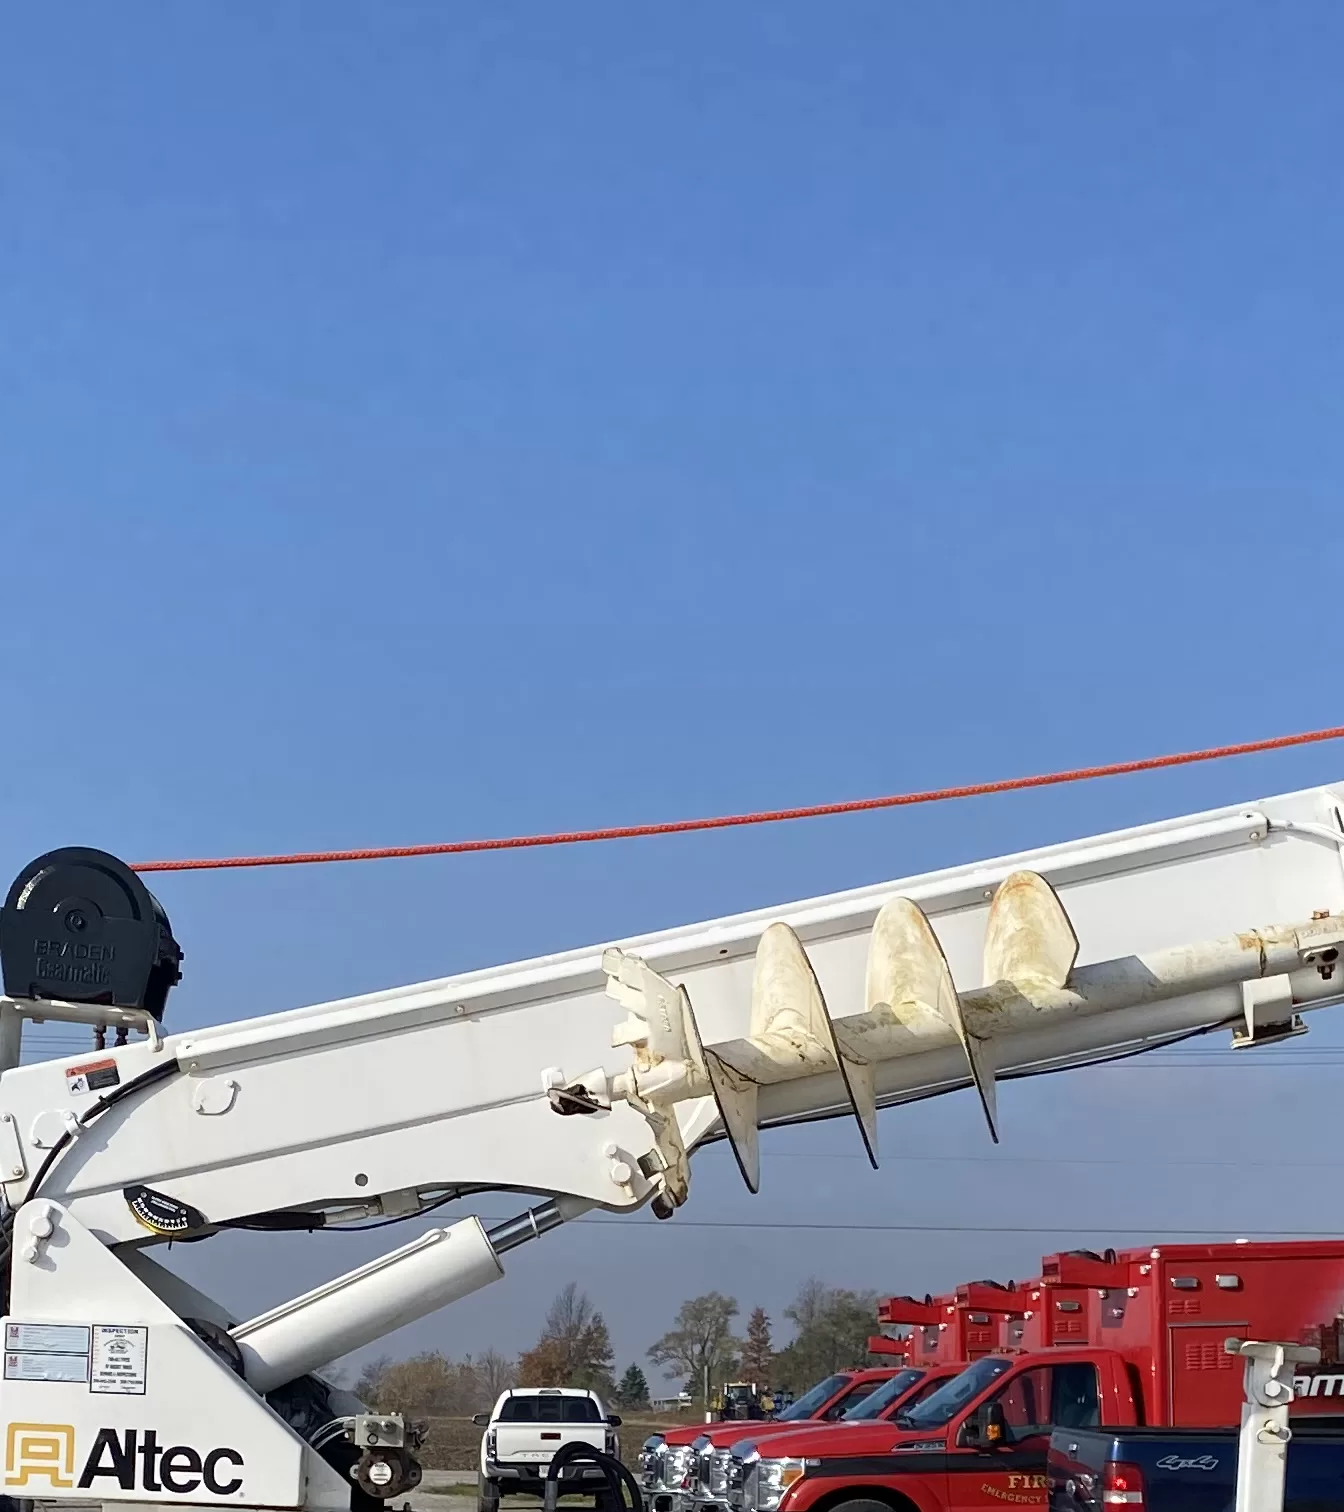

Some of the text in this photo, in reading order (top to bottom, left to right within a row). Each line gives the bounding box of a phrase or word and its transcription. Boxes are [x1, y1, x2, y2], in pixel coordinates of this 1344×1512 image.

[34, 940, 115, 961] BRADEN
[77, 1428, 244, 1495] Altec
[1008, 1474, 1048, 1489] FIR
[980, 1483, 1042, 1504] EMERGENCY
